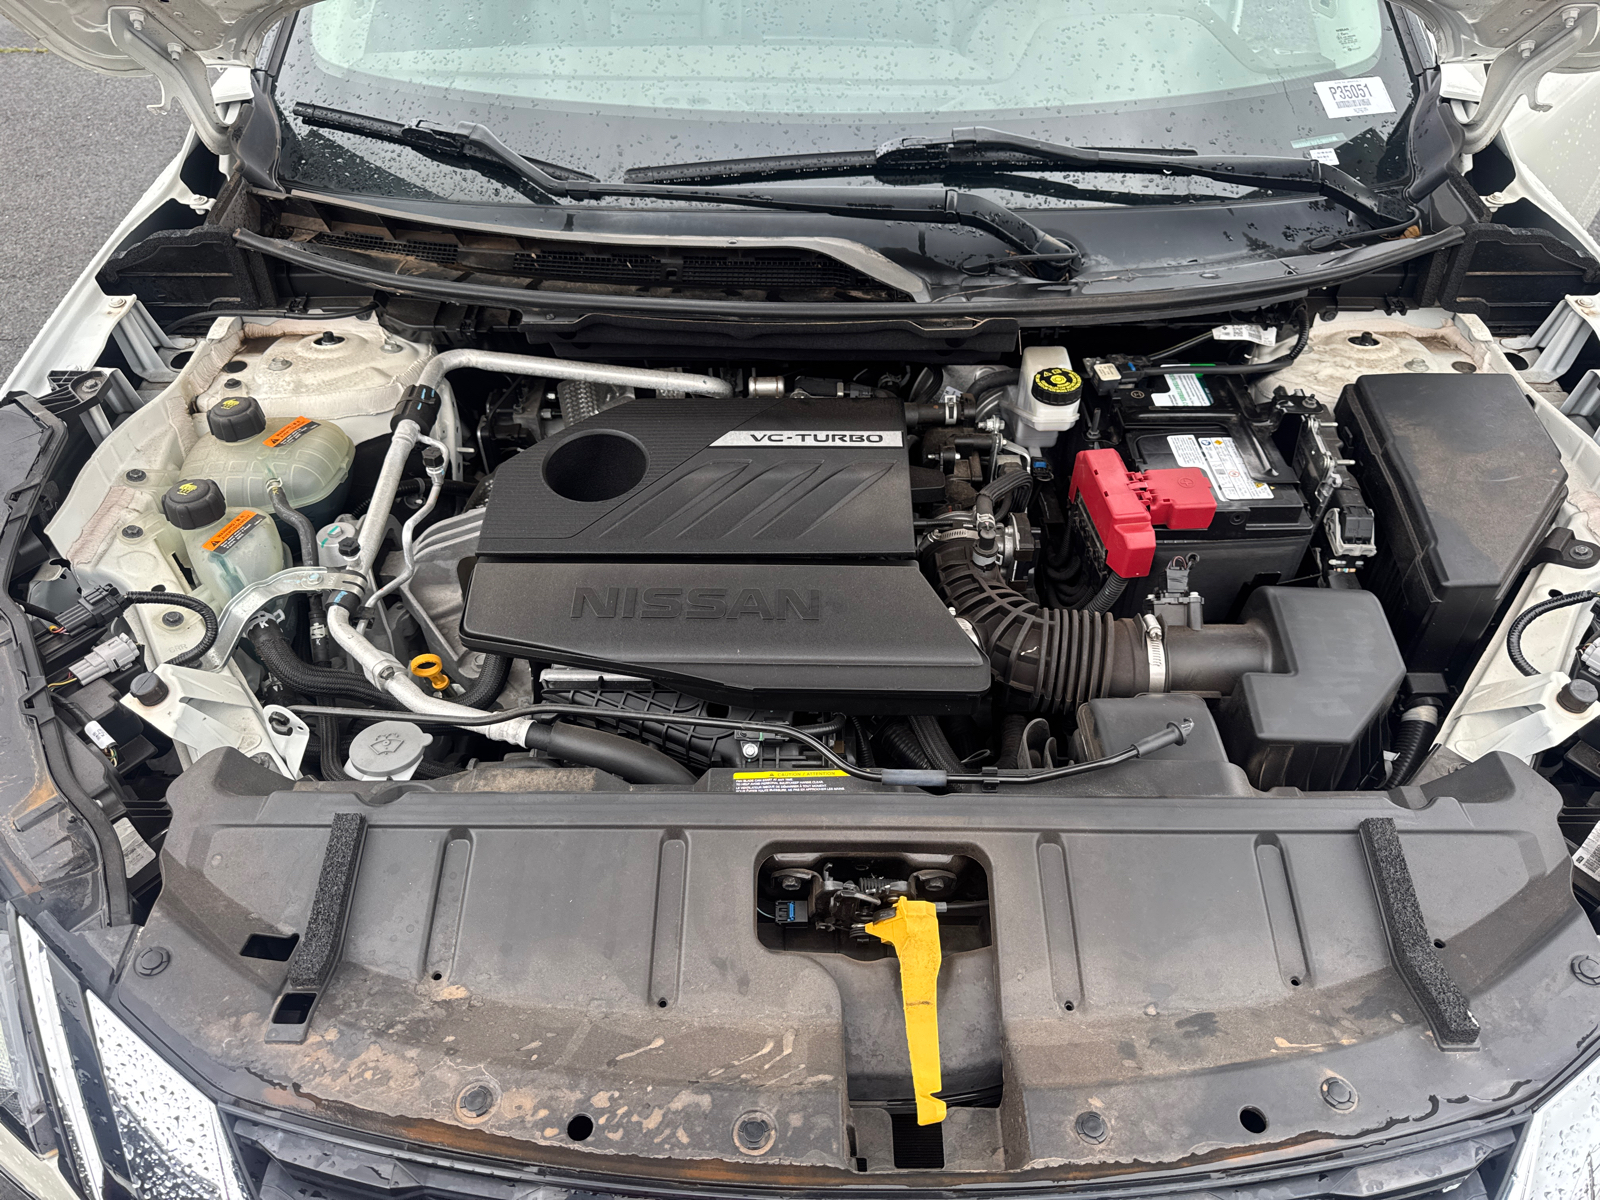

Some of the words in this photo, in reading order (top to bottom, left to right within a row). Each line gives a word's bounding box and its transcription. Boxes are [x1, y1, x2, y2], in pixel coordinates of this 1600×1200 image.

[1329, 83, 1372, 101] P35051
[750, 433, 883, 443] VC-TURBO
[570, 587, 821, 621] NISSAN
